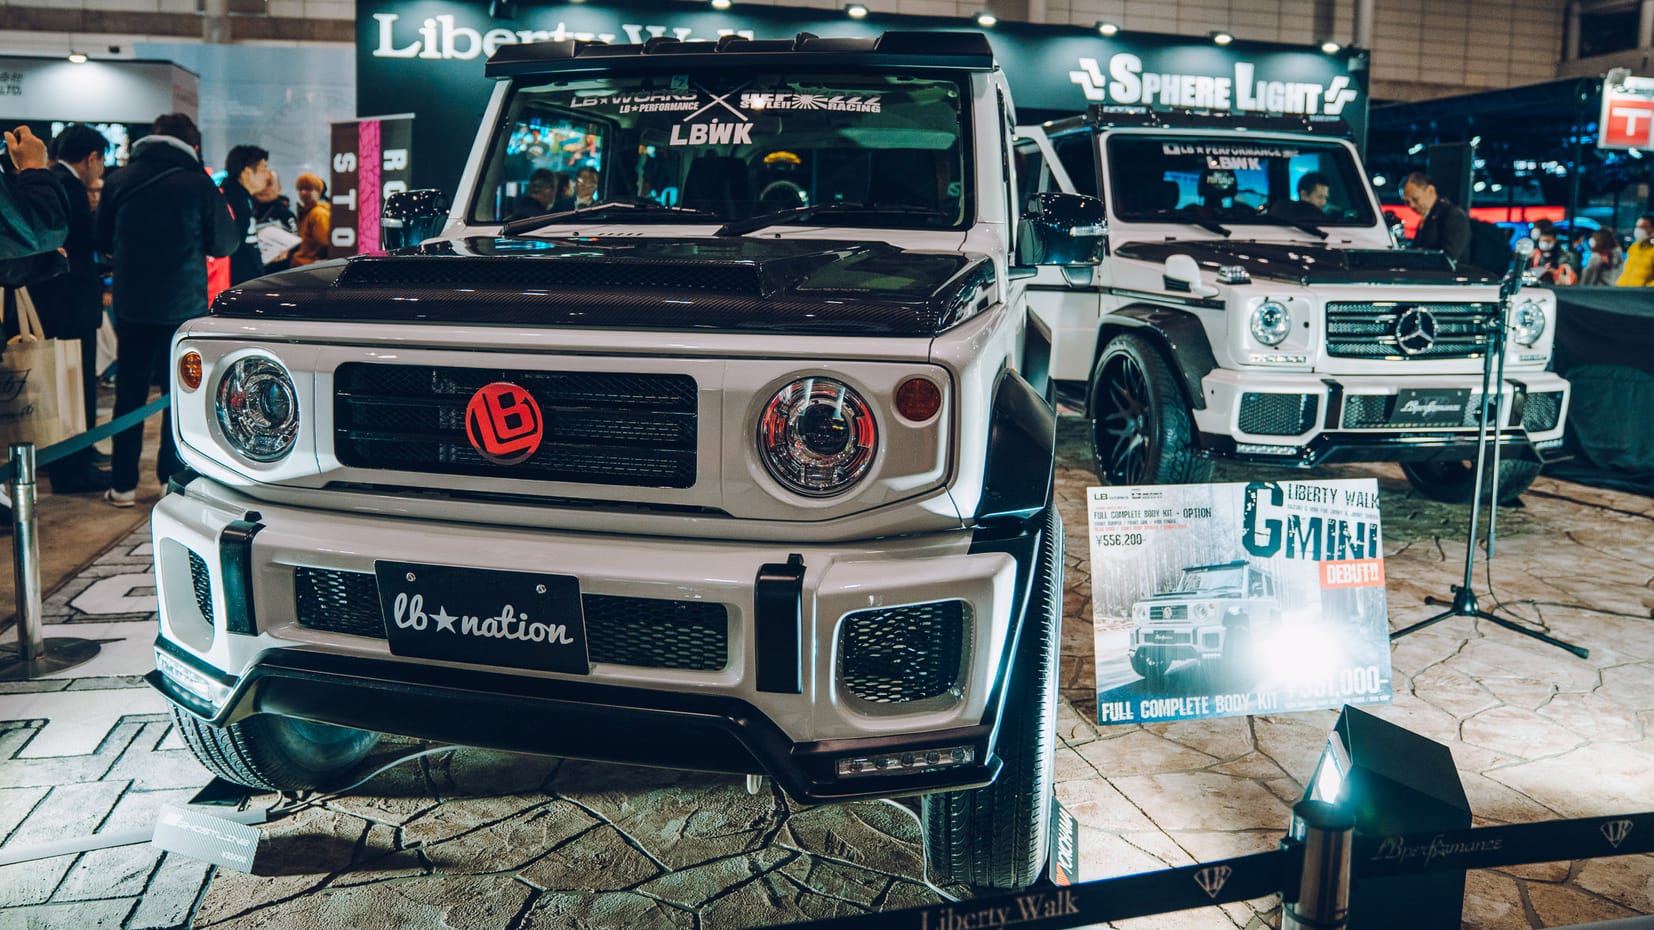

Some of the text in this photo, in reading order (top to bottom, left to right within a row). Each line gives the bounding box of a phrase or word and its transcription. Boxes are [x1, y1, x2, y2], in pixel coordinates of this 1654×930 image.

[372, 13, 616, 60] Libert
[1109, 53, 1323, 114] SPHERE LIGHT
[827, 102, 881, 113] RACING
[669, 119, 754, 145] LBWK
[1206, 156, 1262, 170] LBWK
[1288, 483, 1379, 509] LIBERTY WALK
[1111, 510, 1141, 519] COMPLETE
[1183, 508, 1212, 518] OPTION
[1101, 701, 1134, 722] FULL
[1140, 696, 1209, 719] COMPLETE
[1215, 692, 1251, 713] BODY
[1257, 691, 1278, 710] KIT
[920, 906, 1011, 930] Liberty
[1017, 890, 1080, 921] Walk
